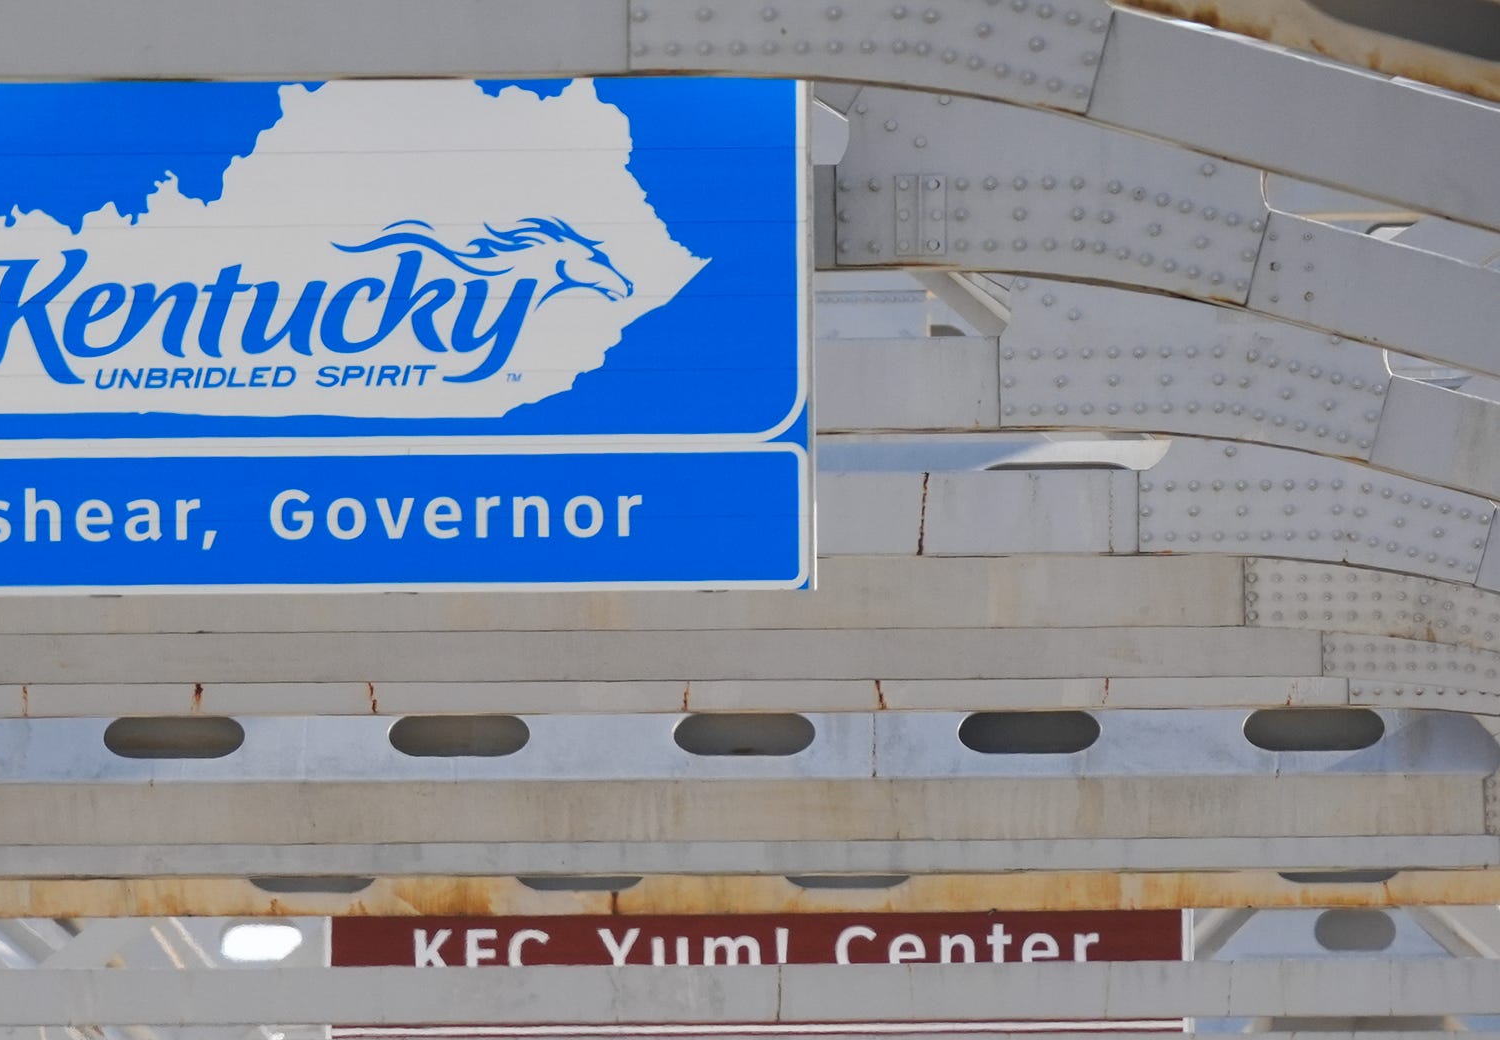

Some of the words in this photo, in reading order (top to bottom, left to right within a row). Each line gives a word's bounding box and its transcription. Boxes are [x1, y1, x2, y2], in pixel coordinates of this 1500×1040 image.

[95, 366, 297, 389] UNBRIDLED
[316, 365, 437, 388] SPIRIT
[270, 490, 643, 540] Governor
[413, 928, 550, 966] KFC
[597, 927, 788, 966] Yum!
[834, 923, 1100, 964] Center
